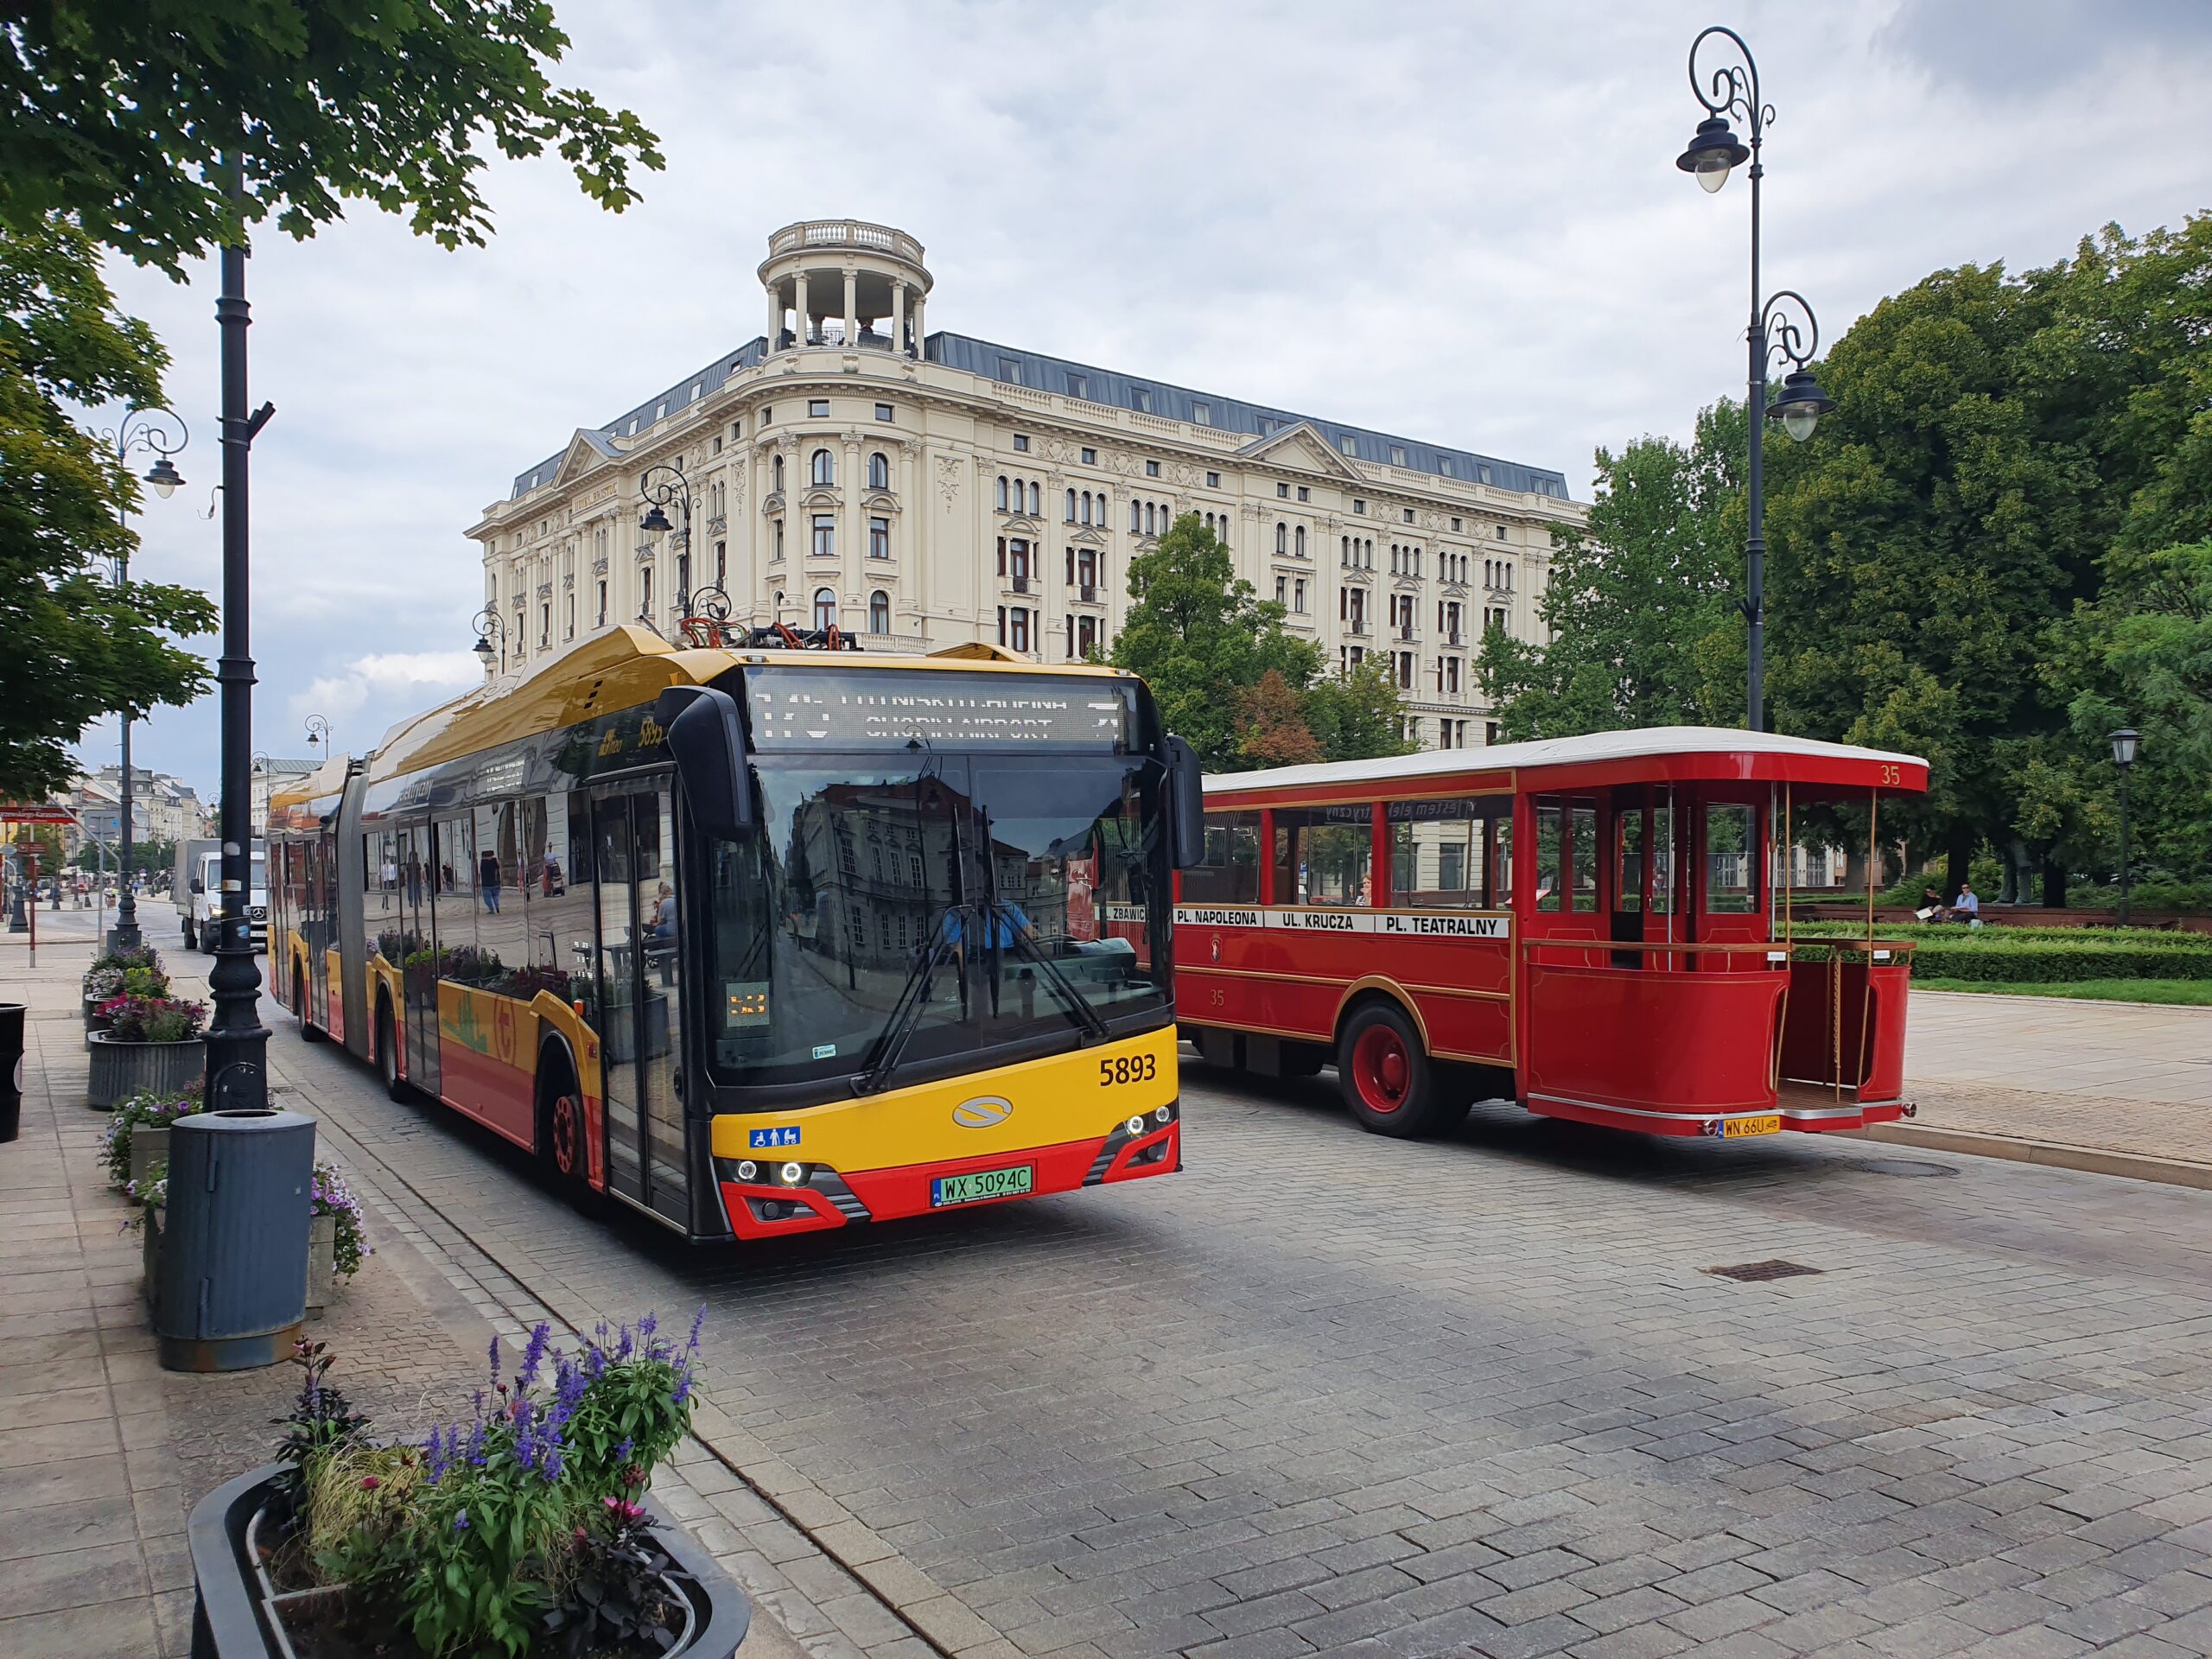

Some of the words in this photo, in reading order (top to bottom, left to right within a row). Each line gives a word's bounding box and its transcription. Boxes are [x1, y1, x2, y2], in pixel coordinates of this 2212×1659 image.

[1880, 765, 1900, 785] 35
[1177, 910, 1192, 923] PL.
[1195, 910, 1257, 925] NAPOLEONA
[1282, 912, 1300, 927] UL.
[1305, 913, 1354, 930] KRUCZA
[1386, 917, 1407, 932] PL.
[1412, 917, 1497, 936] TEATRALNY
[1210, 988, 1224, 1007] 35
[1100, 1053, 1156, 1087] 5893
[1726, 1121, 1741, 1135] WN
[1744, 1118, 1764, 1135] 66U
[944, 1177, 968, 1199] WX
[974, 1169, 1027, 1194] 5094C
